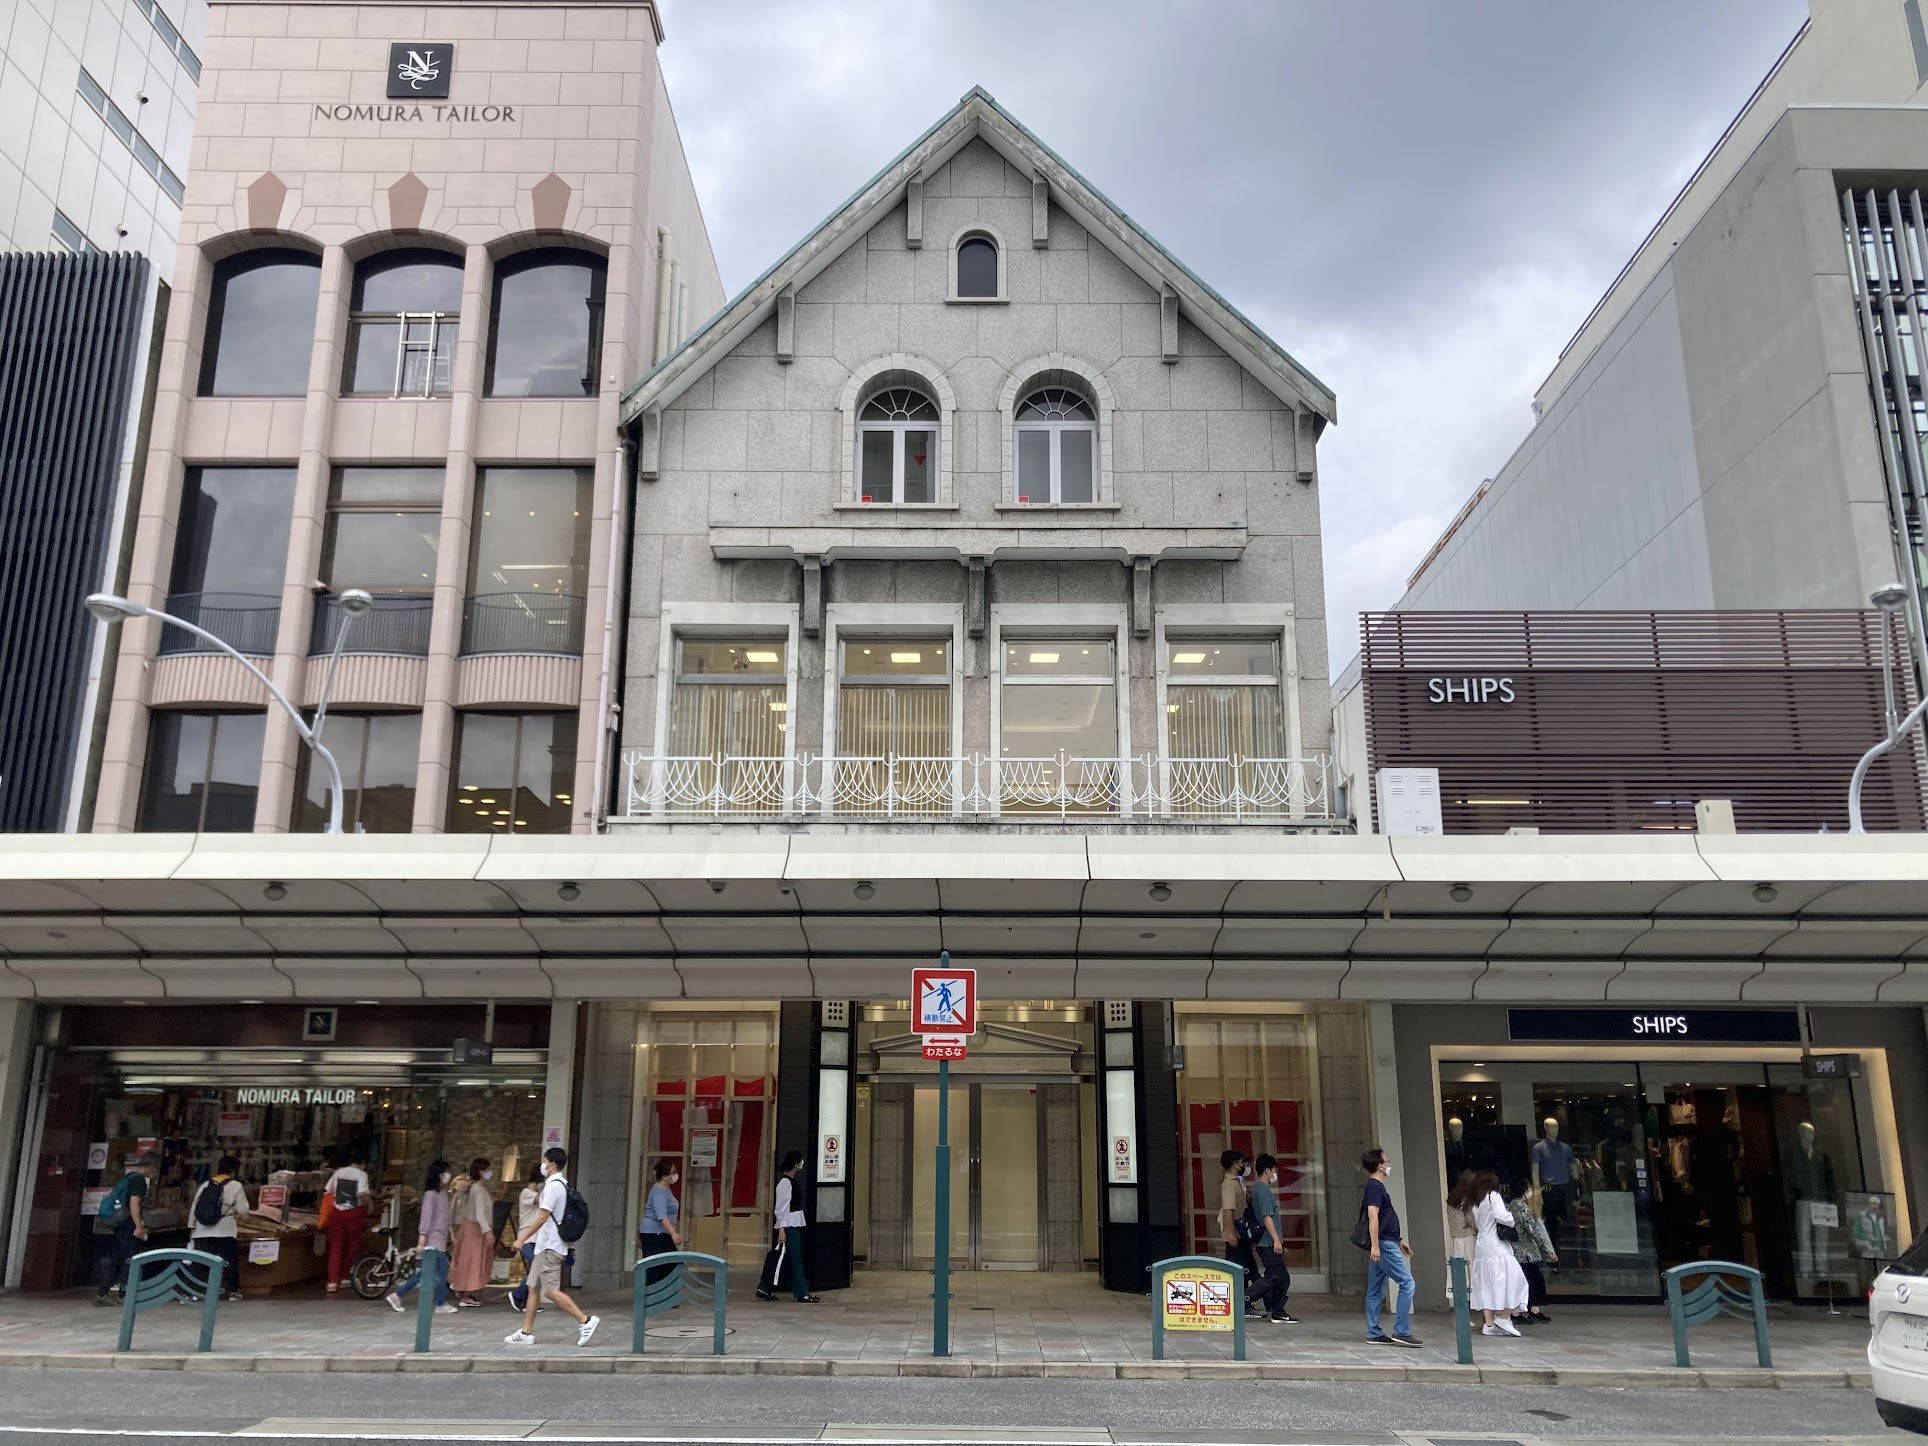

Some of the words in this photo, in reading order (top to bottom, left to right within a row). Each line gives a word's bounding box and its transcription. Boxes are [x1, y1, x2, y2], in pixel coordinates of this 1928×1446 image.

[314, 104, 423, 122] NOMURA
[432, 105, 516, 122] TAILOR
[1428, 677, 1515, 703] SHIPS
[924, 1013, 954, 1023] 横断禁止
[1632, 1016, 1688, 1034] SHIPS
[926, 1047, 962, 1057] わたるな
[1816, 1060, 1836, 1073] SHIPS
[237, 1089, 300, 1104] NOMURA
[305, 1089, 356, 1104] TAILOR
